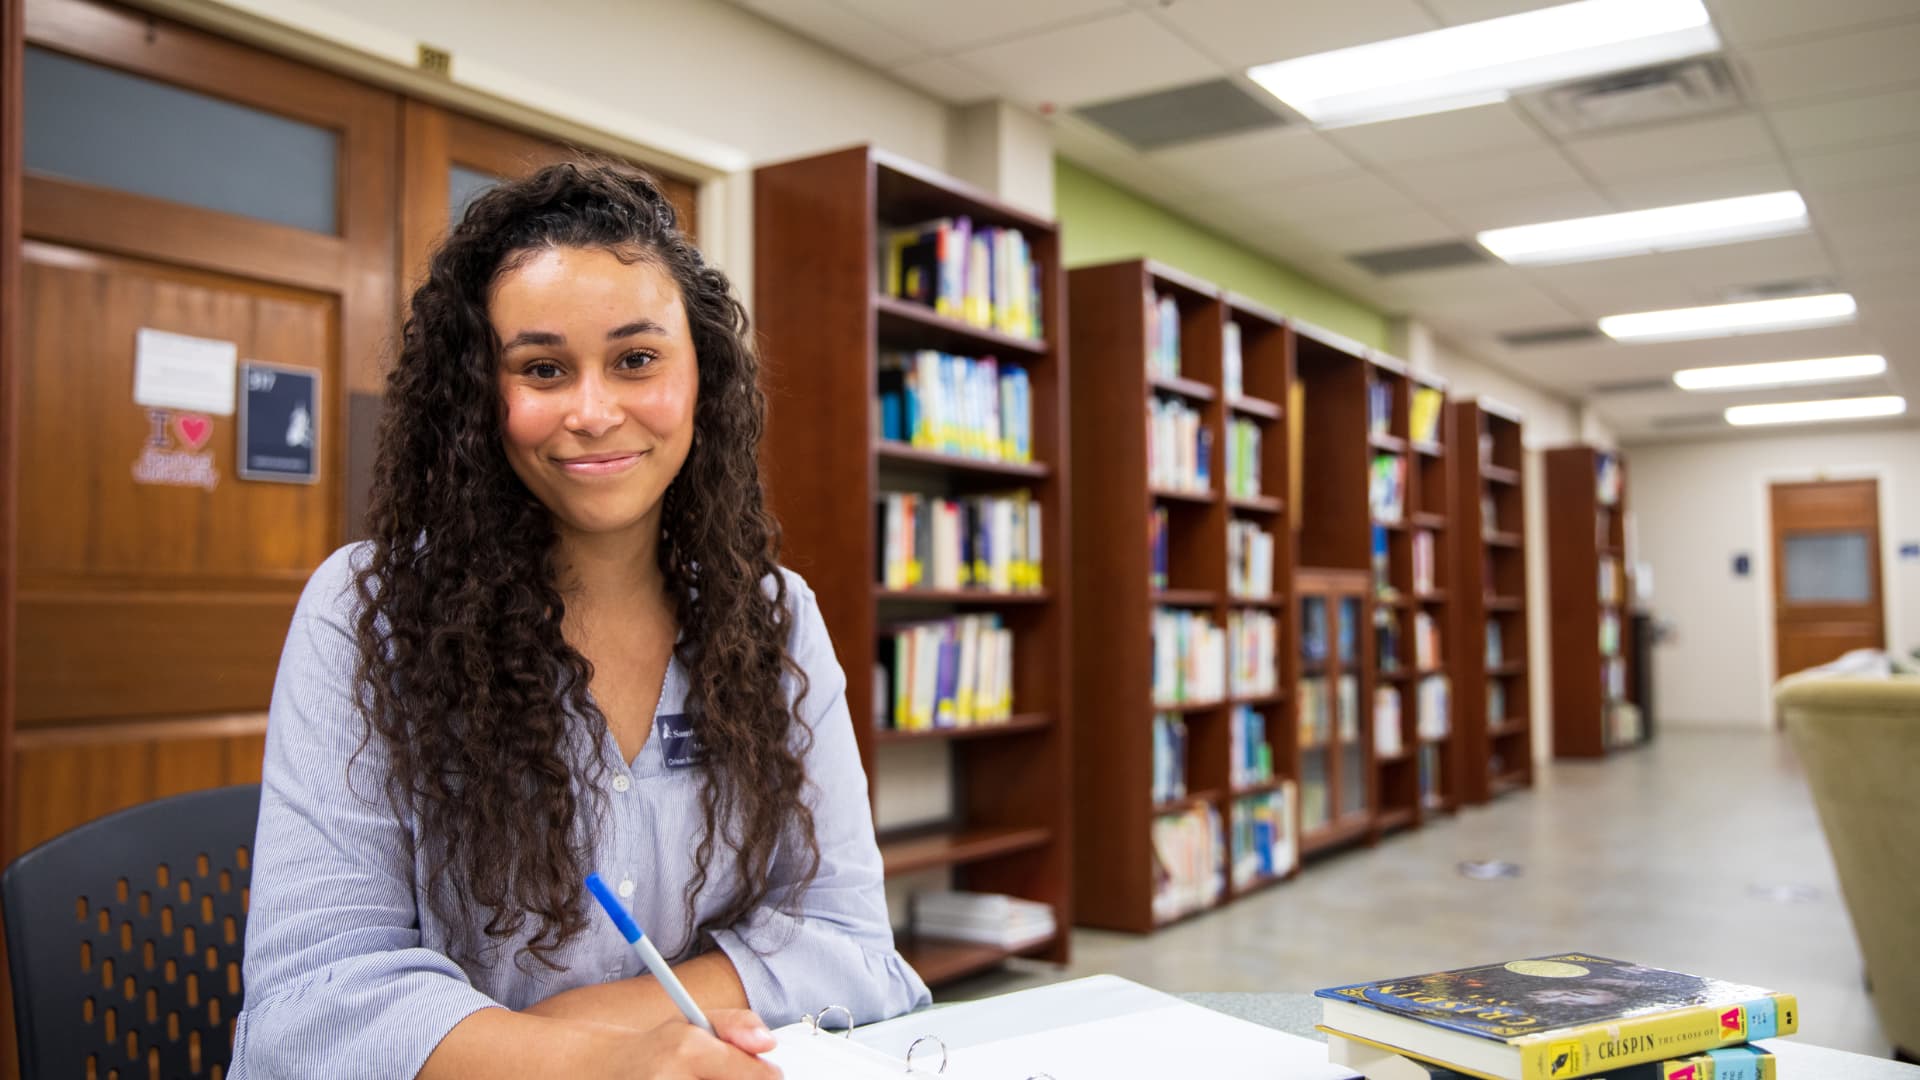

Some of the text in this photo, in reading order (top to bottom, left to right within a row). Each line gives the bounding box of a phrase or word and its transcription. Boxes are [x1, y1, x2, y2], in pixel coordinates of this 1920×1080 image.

[1598, 1033, 1654, 1060] CRISPIN
[1657, 1036, 1673, 1046] THE
[1676, 1030, 1702, 1042] CROSS
[1703, 1028, 1714, 1037] OF
[1668, 1063, 1696, 1080] A
